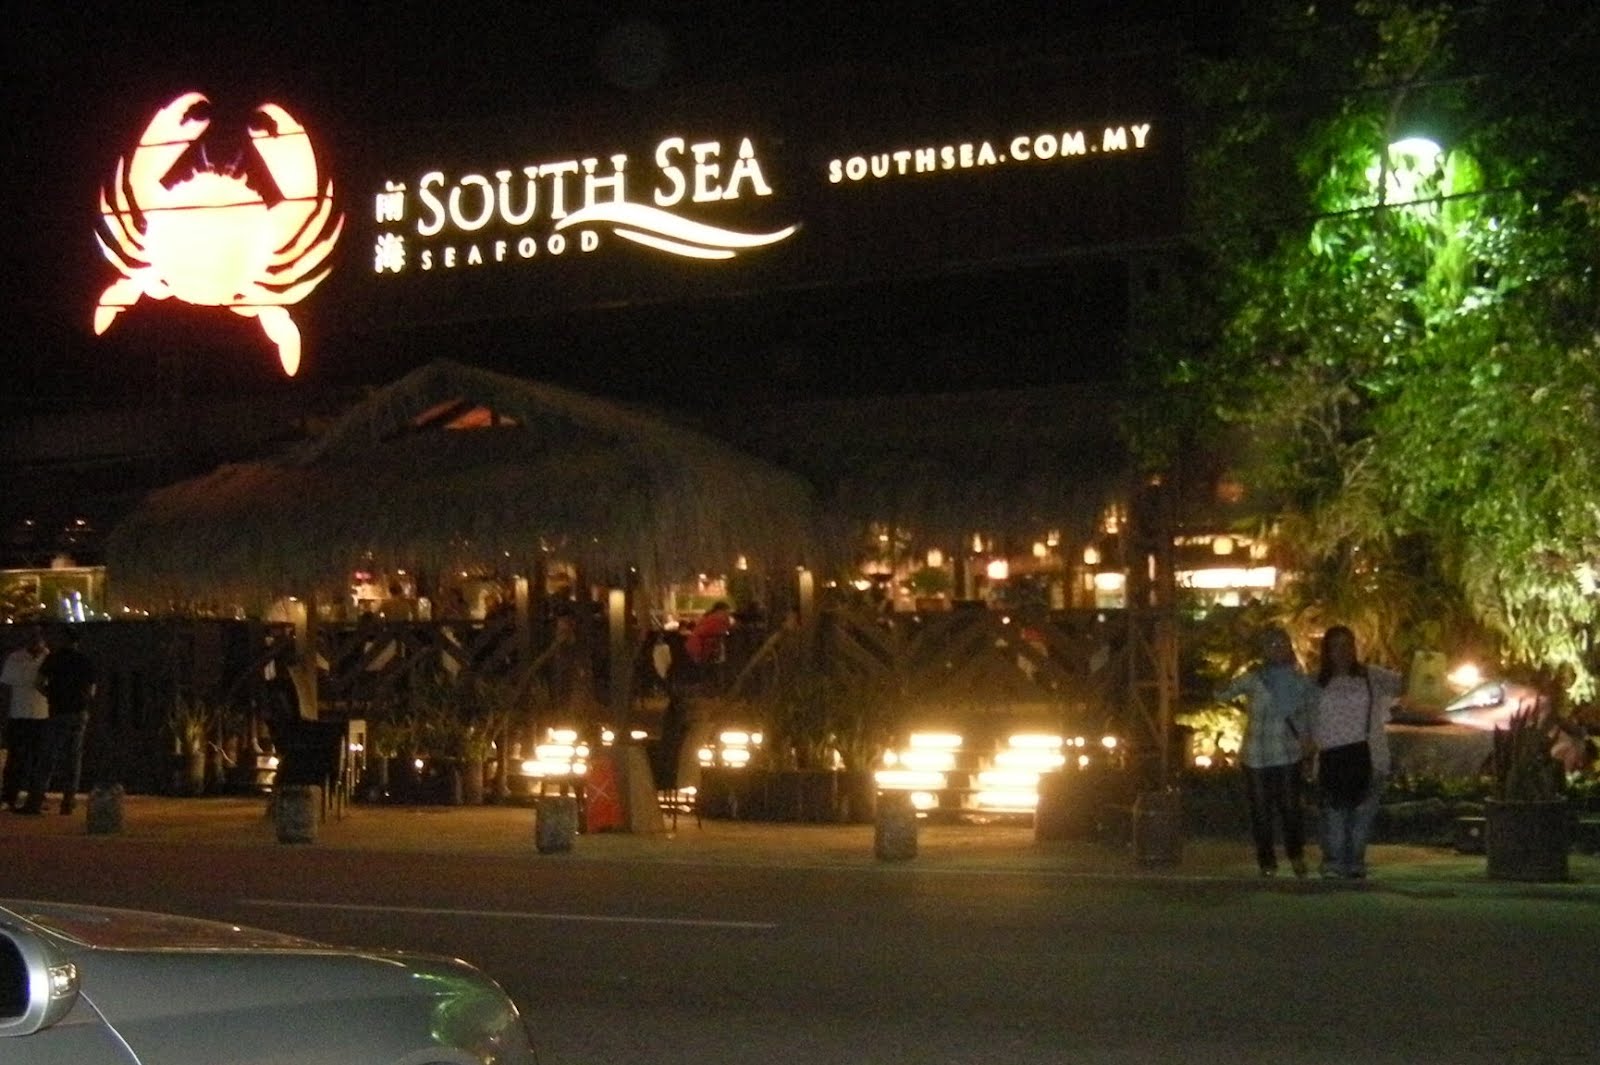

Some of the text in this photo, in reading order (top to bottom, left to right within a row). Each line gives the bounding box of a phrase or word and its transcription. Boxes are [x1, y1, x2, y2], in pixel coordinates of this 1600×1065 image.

[828, 123, 1151, 184] SOUTHSEA.COM.MY
[417, 136, 773, 237] SOUTH SEA
[421, 229, 599, 271] SEAFOOD
